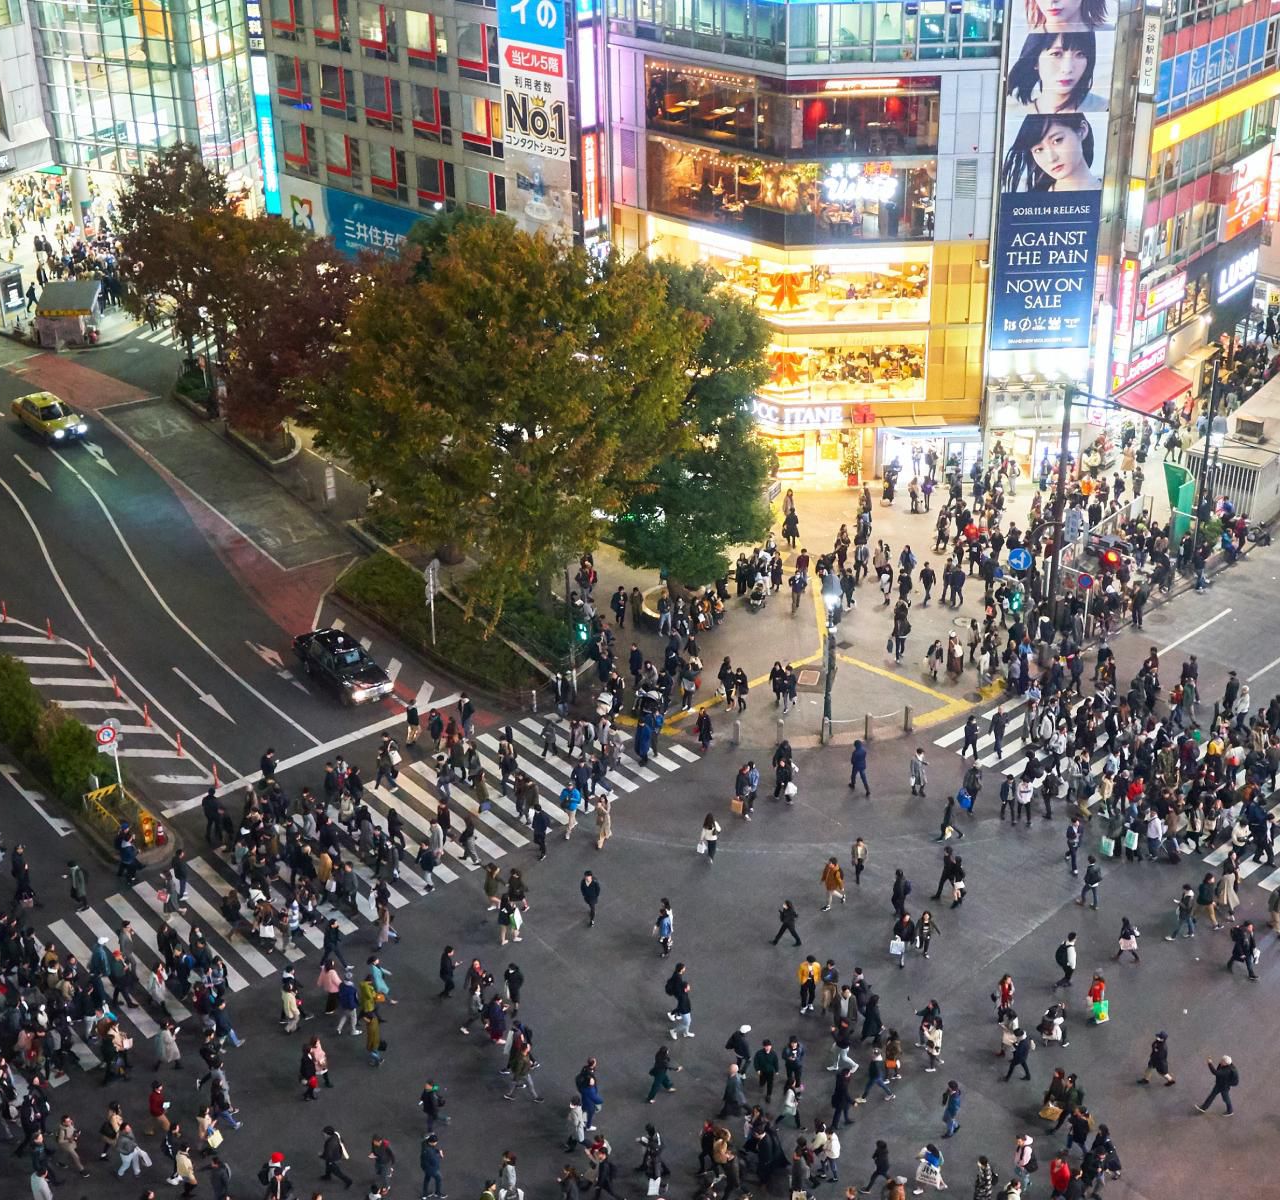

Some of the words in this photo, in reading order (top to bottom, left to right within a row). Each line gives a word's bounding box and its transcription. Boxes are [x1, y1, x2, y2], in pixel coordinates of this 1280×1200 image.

[511, 49, 559, 73] 当ビル5階
[1143, 22, 1156, 87] 渋谷駅前ビル
[514, 75, 552, 94] 利用者数
[504, 89, 567, 144] No.1
[505, 134, 567, 158] コンタクトショップ
[1013, 207, 1051, 216] 2018.11.14
[1053, 205, 1091, 215] RELEASE
[1006, 251, 1042, 266] THE
[1218, 248, 1259, 294] LUSH
[1006, 278, 1052, 294] NOW
[1055, 277, 1083, 292] ON
[1024, 295, 1062, 309] SALE
